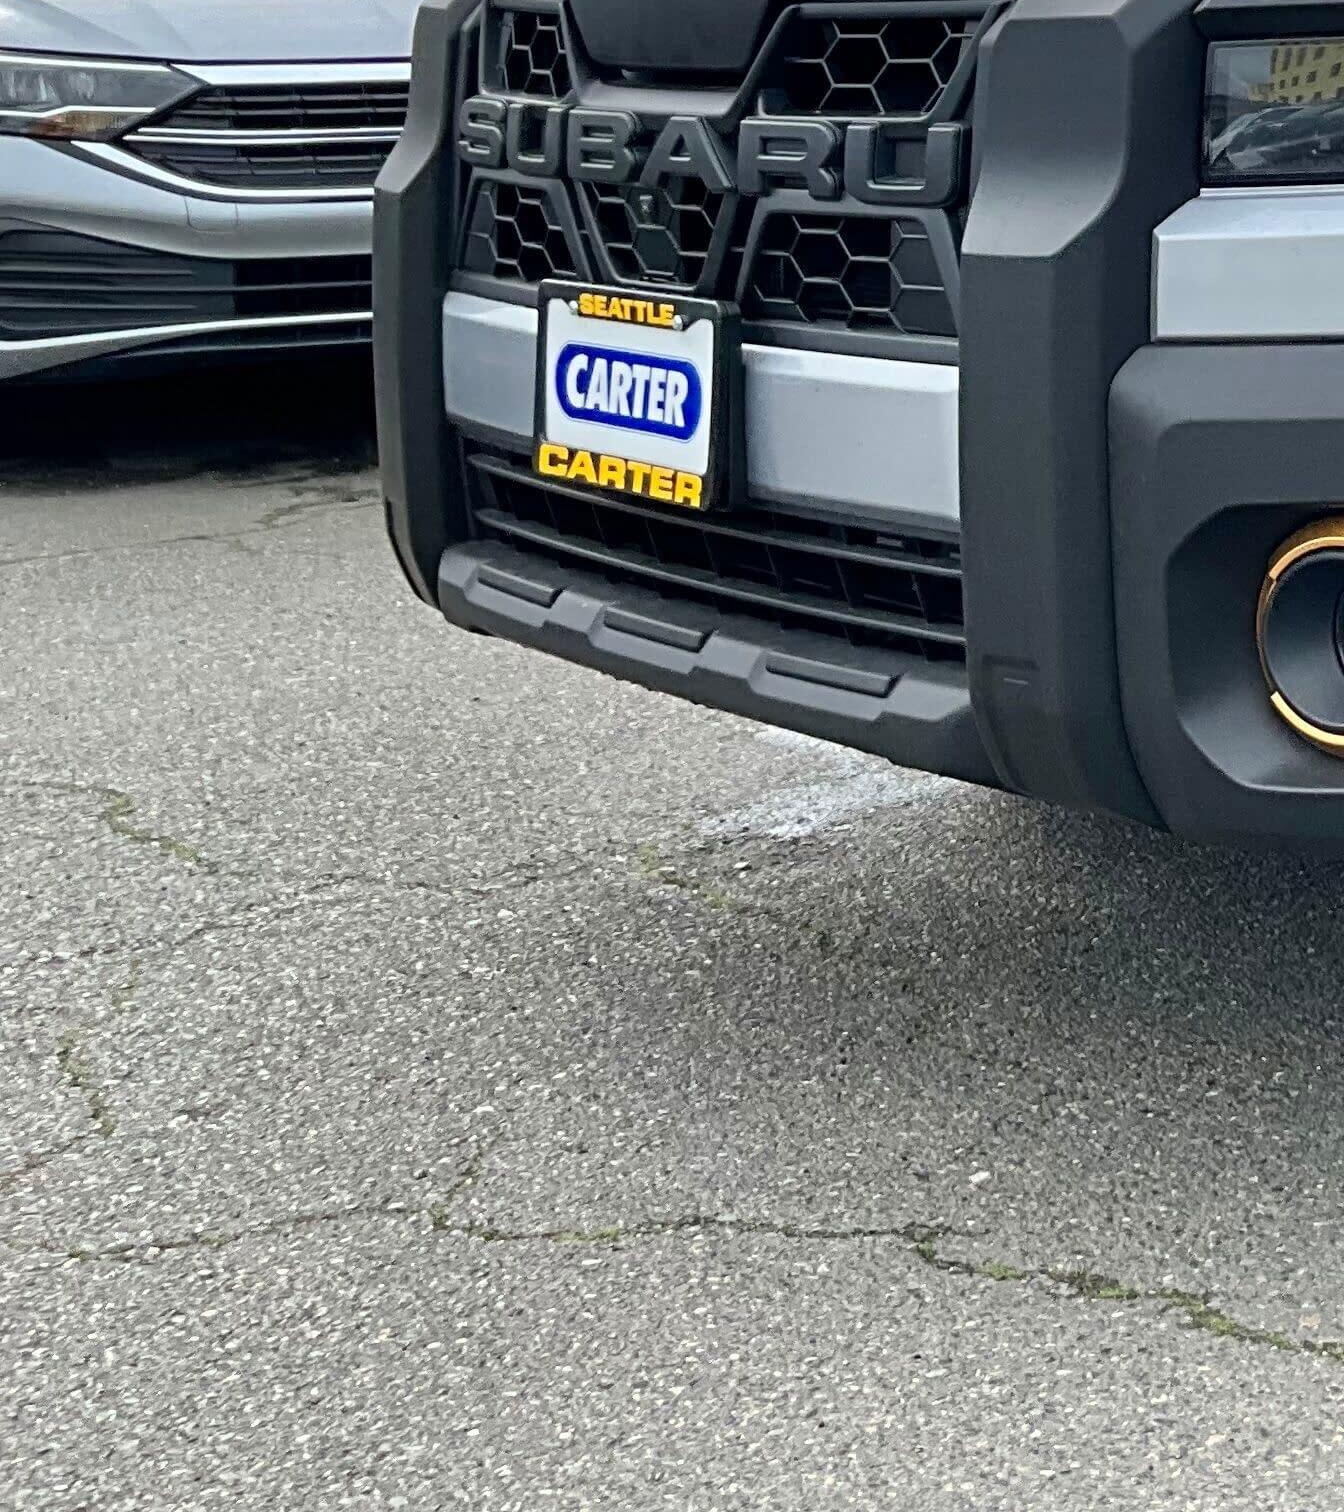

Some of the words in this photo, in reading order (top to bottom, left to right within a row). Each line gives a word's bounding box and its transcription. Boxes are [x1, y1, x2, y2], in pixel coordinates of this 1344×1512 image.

[458, 94, 967, 207] SUBARU
[578, 293, 676, 327] SEATTLE
[565, 353, 689, 428] CARTER
[538, 443, 703, 508] CARTER
